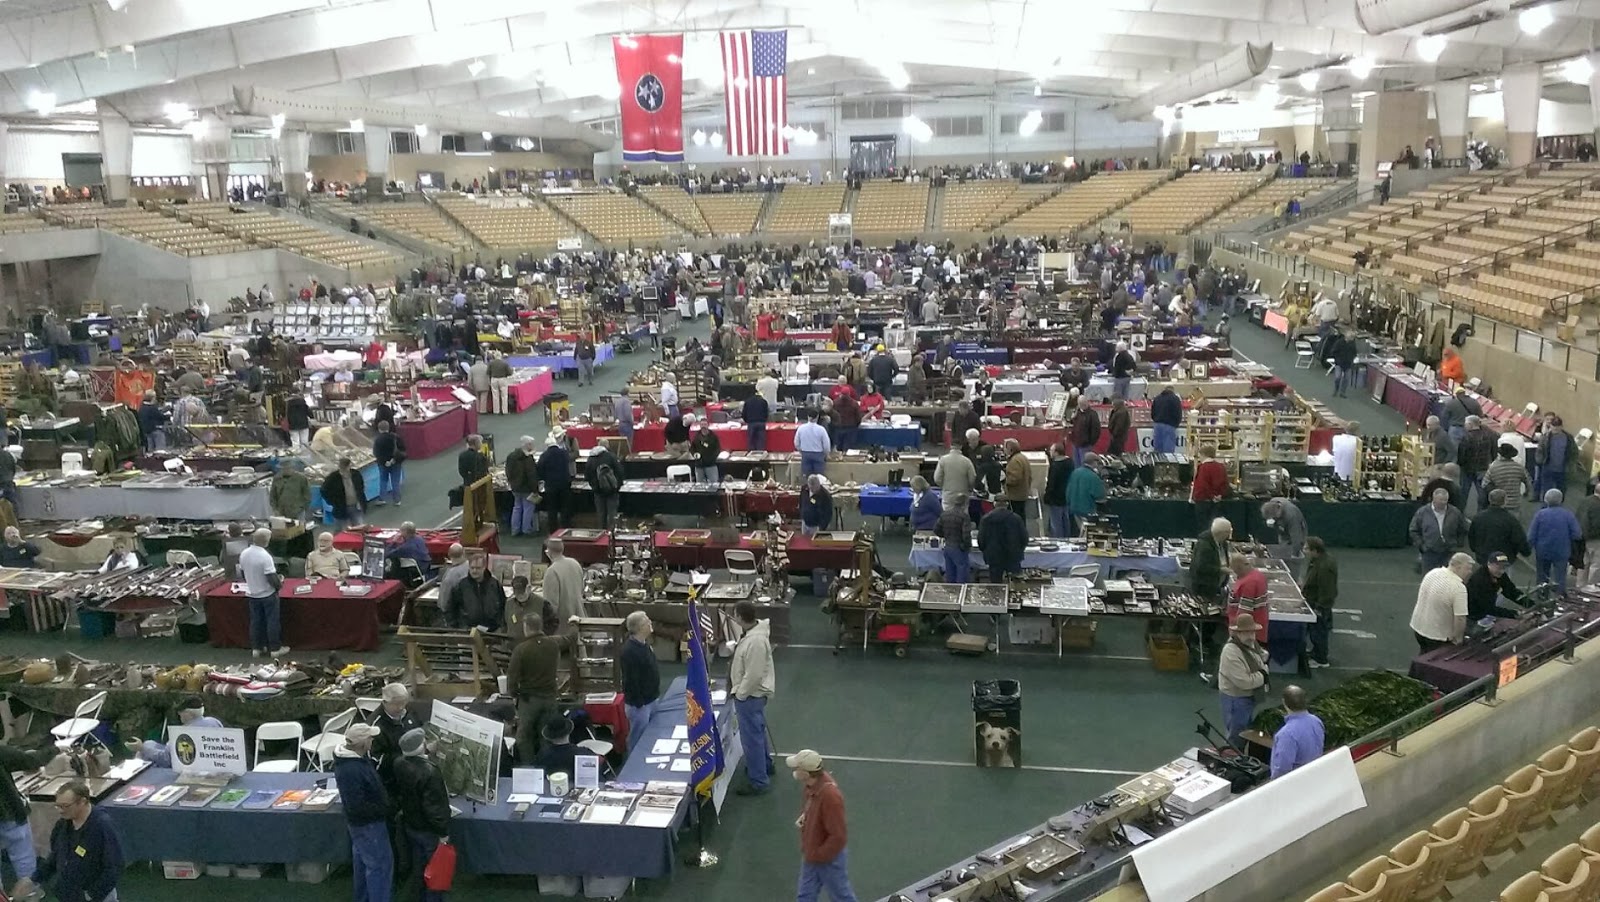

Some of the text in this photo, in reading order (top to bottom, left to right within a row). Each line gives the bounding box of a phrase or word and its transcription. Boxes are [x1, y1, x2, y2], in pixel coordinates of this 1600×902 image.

[201, 735, 220, 743] Save
[203, 744, 235, 752] Franklin
[199, 752, 240, 761] Battlefield
